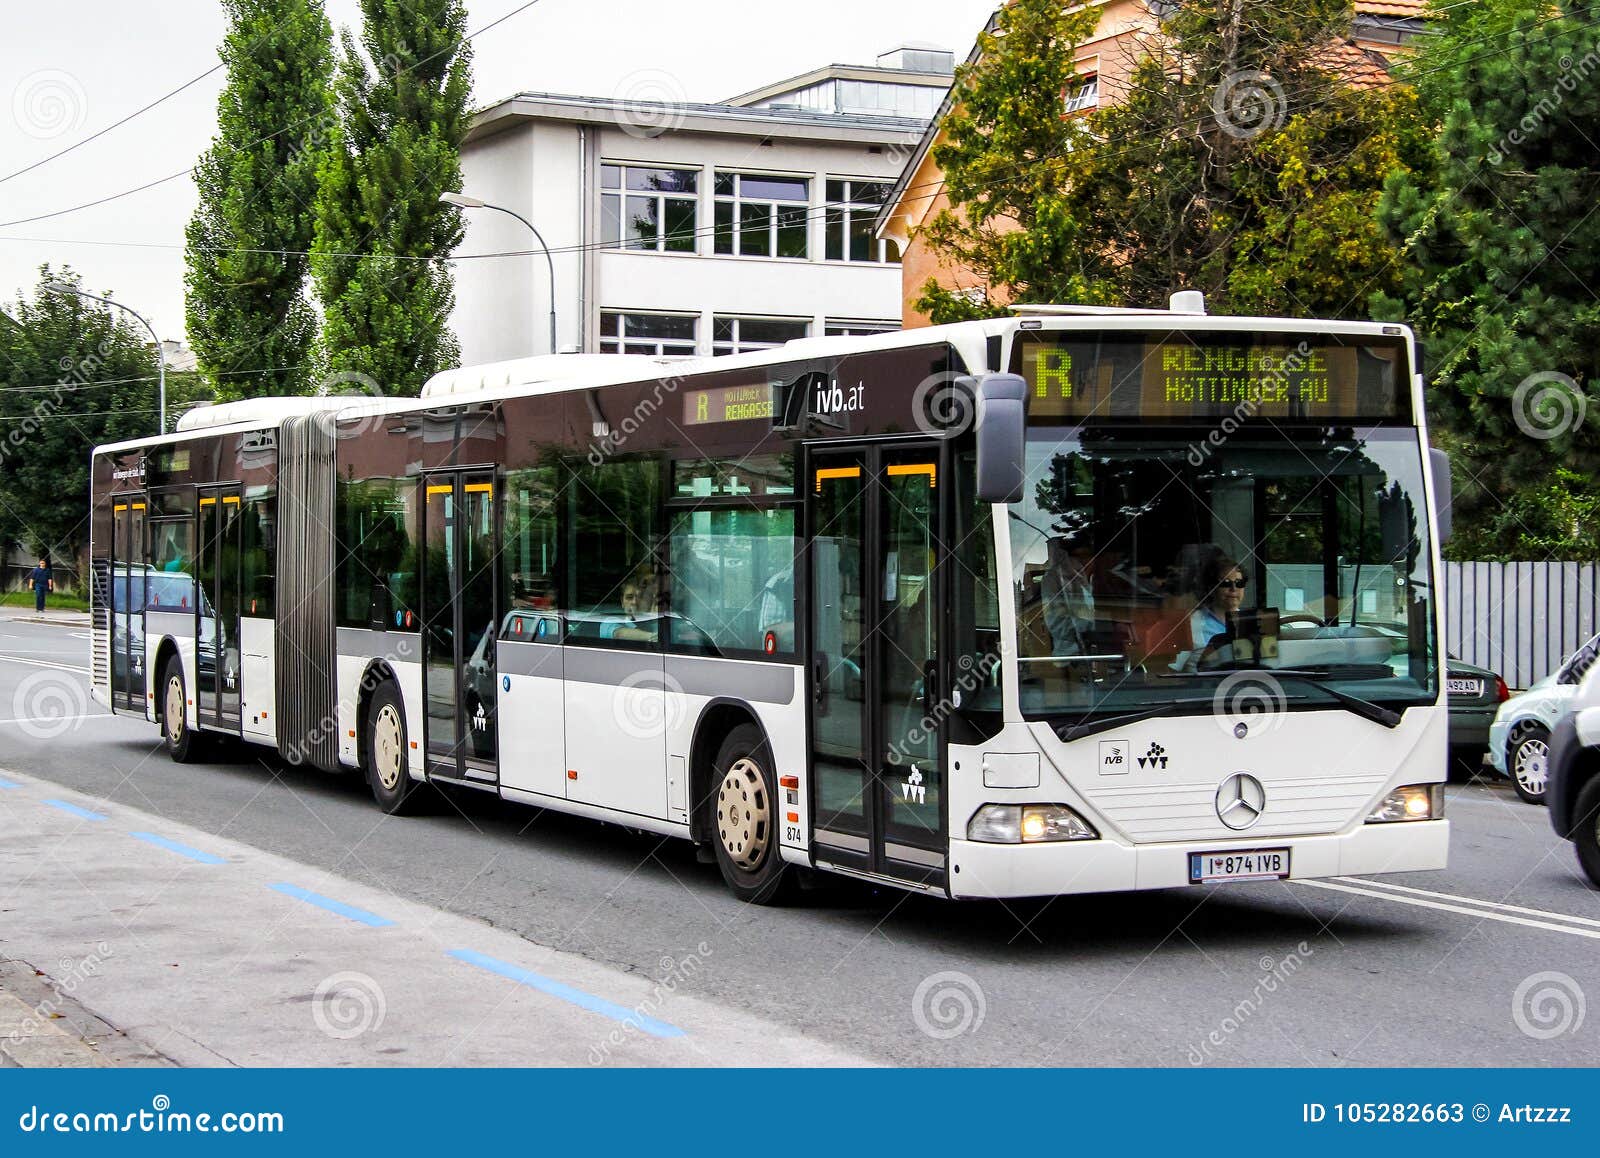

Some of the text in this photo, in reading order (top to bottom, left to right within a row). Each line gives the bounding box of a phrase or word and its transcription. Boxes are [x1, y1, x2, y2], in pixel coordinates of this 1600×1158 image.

[1162, 347, 1329, 372] REHGASSE
[1036, 349, 1073, 399] R
[816, 380, 865, 414] ivb.at
[1299, 377, 1329, 402] AU
[696, 393, 709, 421] R
[725, 401, 774, 421] REHGASSE
[1104, 755, 1123, 765] IVB
[1137, 756, 1169, 770] VVT
[901, 782, 926, 805] VVT
[786, 826, 801, 843] 874
[1209, 858, 1214, 875] I
[1225, 854, 1253, 874] 874
[1257, 854, 1281, 873] IVB
